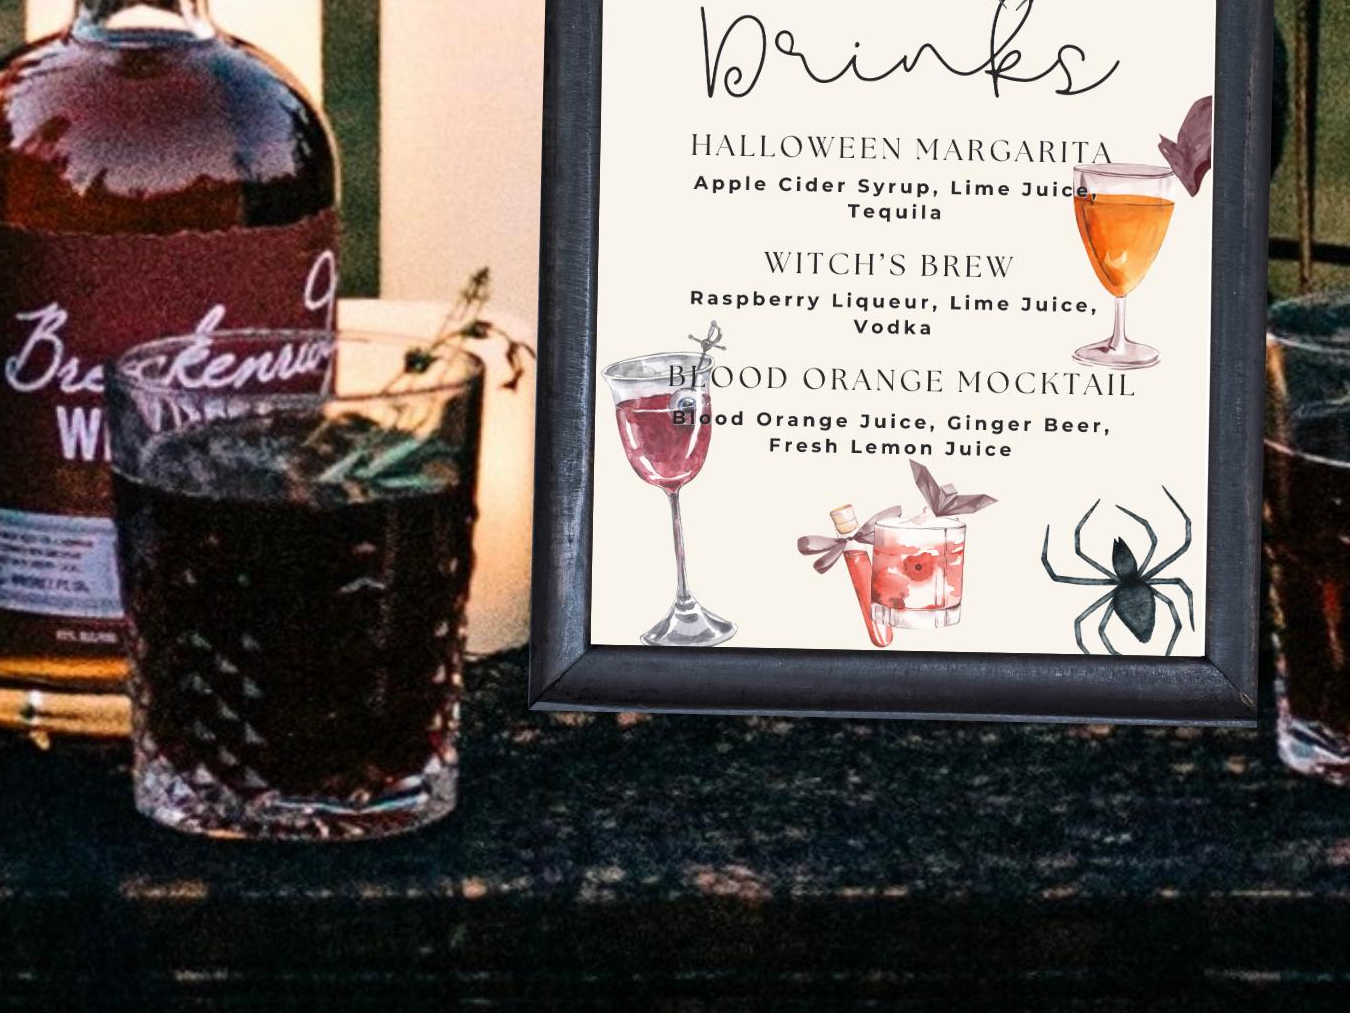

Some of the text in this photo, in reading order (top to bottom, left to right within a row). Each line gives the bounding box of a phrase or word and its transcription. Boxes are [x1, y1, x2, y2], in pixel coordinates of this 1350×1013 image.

[690, 133, 1113, 164] HALLOWEEN MARGARITA
[693, 175, 1097, 202] Apple Cider Syrup, Lime Juice,
[847, 203, 942, 223] Tequila
[763, 251, 1015, 278] WITCH'S BREW
[690, 290, 1096, 316] Raspberry Liqueur, Lime Juice,
[853, 319, 931, 336] Vodka
[668, 364, 1135, 396] BLOOD ORANGE MOCKTAIL
[672, 409, 1111, 436] Blood Orange Juice, Ginger Beer,
[769, 437, 1012, 457] Fresh Lemon Juice
